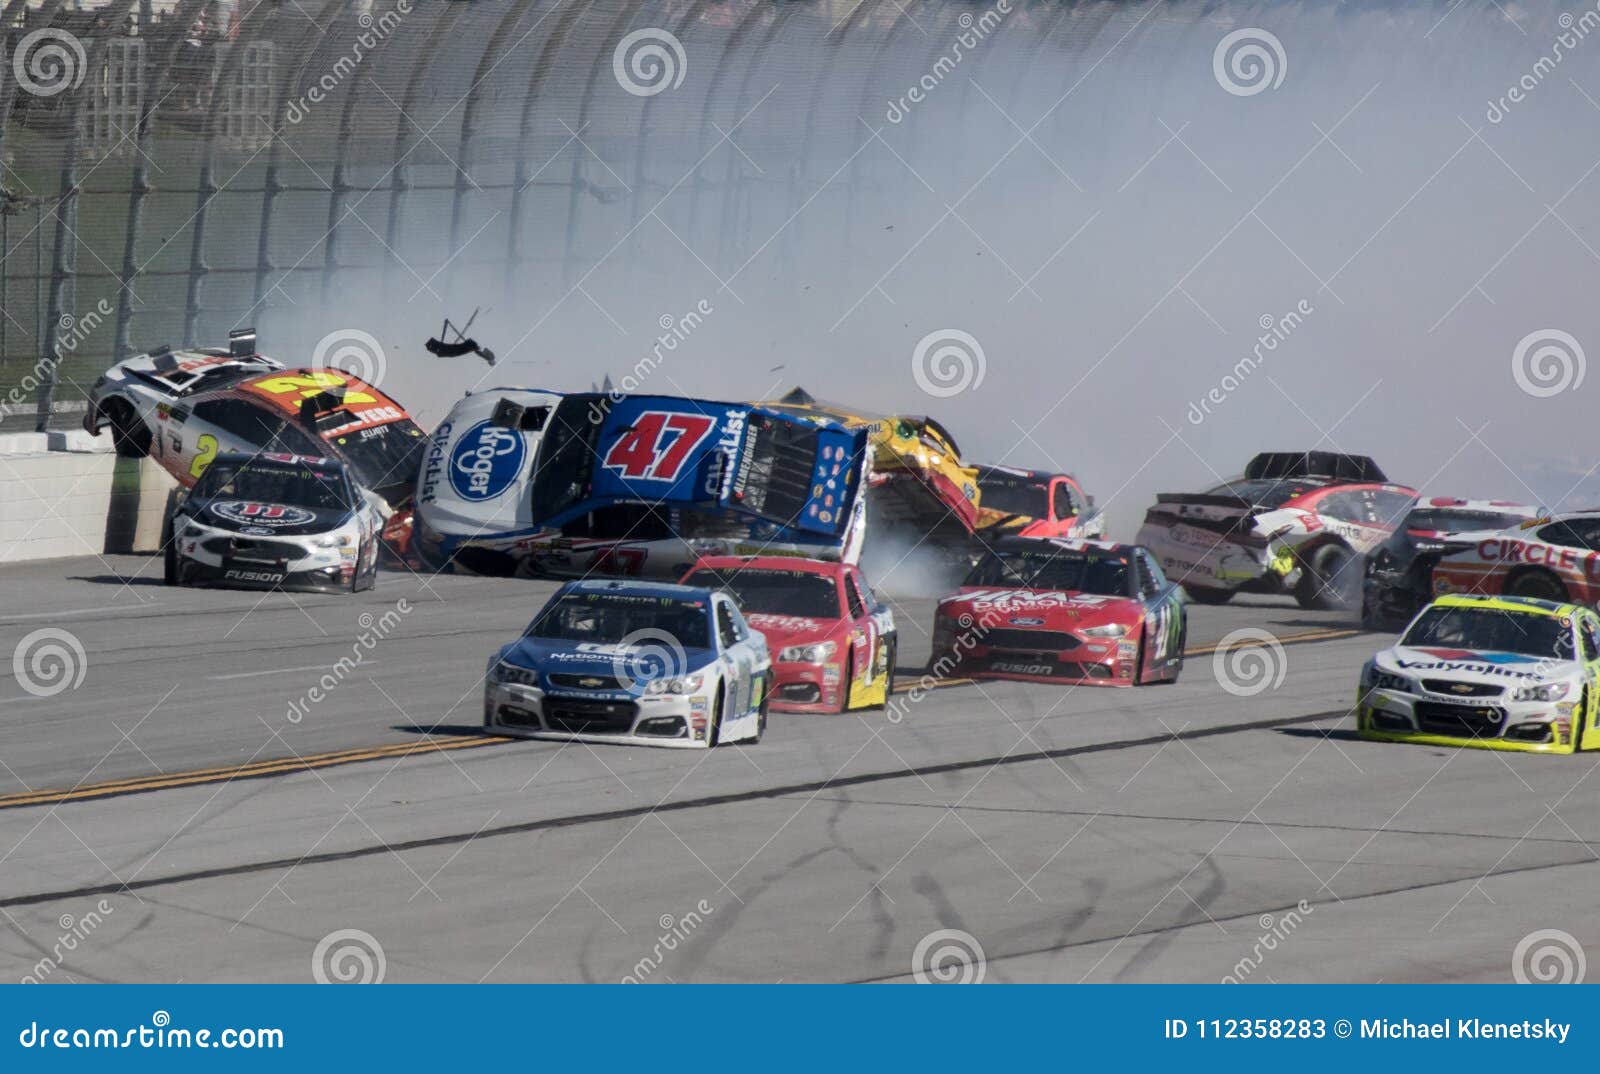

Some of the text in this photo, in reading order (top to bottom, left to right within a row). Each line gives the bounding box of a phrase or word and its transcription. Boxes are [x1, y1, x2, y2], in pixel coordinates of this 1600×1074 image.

[457, 427, 516, 495] Kroger
[602, 410, 718, 483] 47
[1478, 538, 1578, 569] CIRCLE
[224, 569, 284, 583] FUSION
[991, 662, 1054, 675] FUSION
